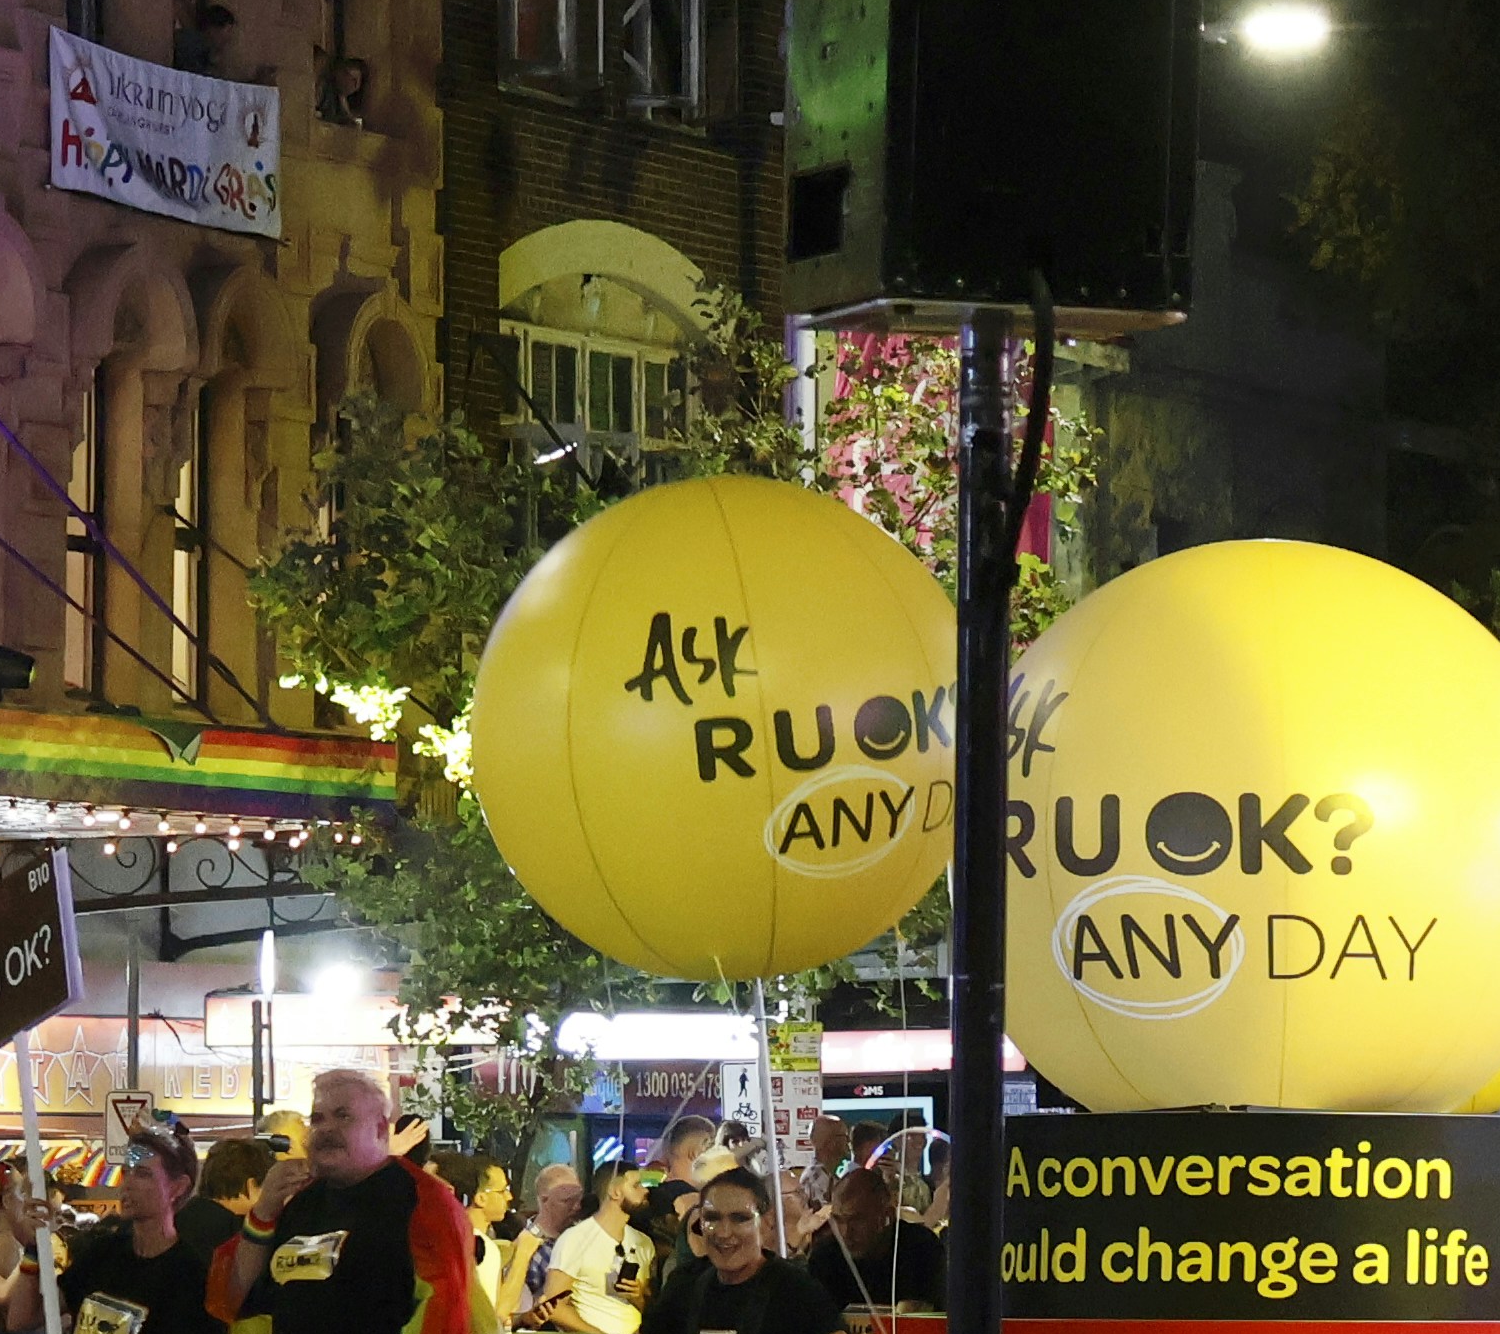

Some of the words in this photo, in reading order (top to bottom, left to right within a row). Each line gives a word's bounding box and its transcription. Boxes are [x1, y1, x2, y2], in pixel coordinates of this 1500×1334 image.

[625, 612, 759, 705] Ask
[854, 679, 956, 761] OK
[1007, 673, 1069, 777] sk
[779, 786, 916, 854] ANY
[1073, 914, 1240, 980] ANY
[1268, 915, 1437, 980] DAY
[636, 1071, 668, 1097] 1300
[1007, 1147, 1030, 1198] A
[1038, 1141, 1453, 1200] conversation
[1001, 1228, 1086, 1283] ould
[1101, 1226, 1339, 1299] change
[1353, 1242, 1390, 1285] a
[1406, 1227, 1490, 1287] life
